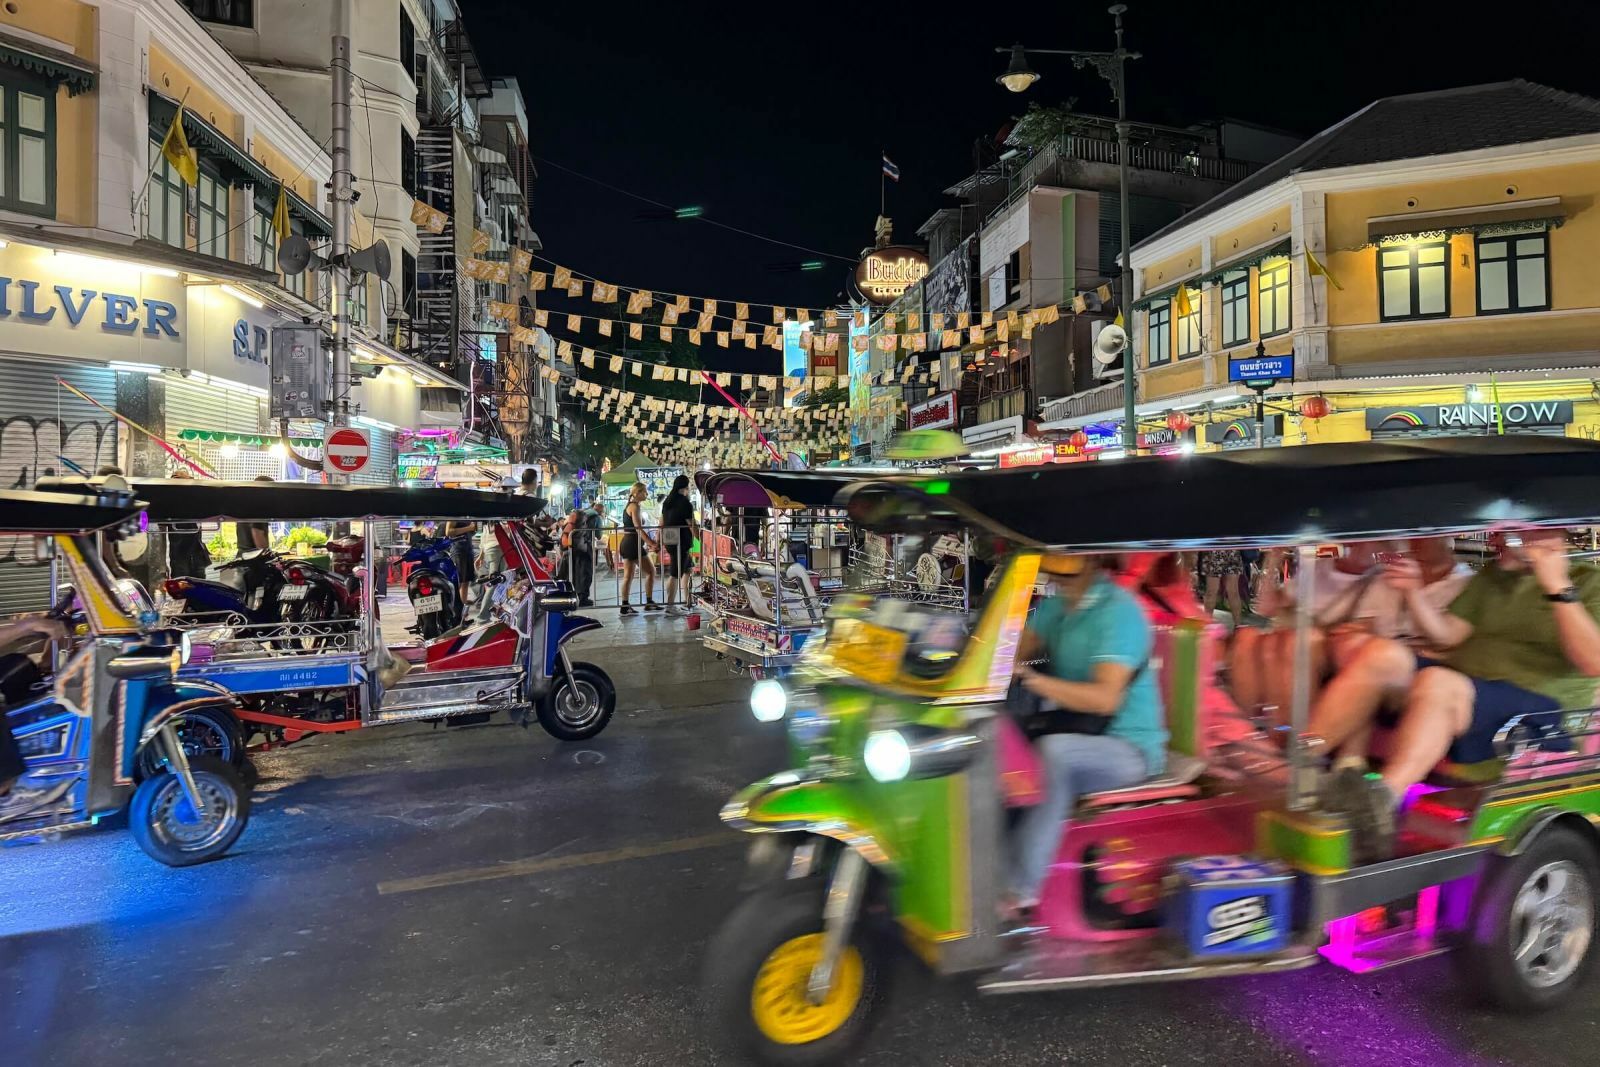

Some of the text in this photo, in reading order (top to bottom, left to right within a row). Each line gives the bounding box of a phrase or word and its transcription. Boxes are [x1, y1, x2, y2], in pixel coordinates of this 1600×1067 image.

[0, 276, 180, 337] ILVER
[1438, 402, 1558, 425] RAINBOW
[1144, 430, 1173, 445] RAINBOW
